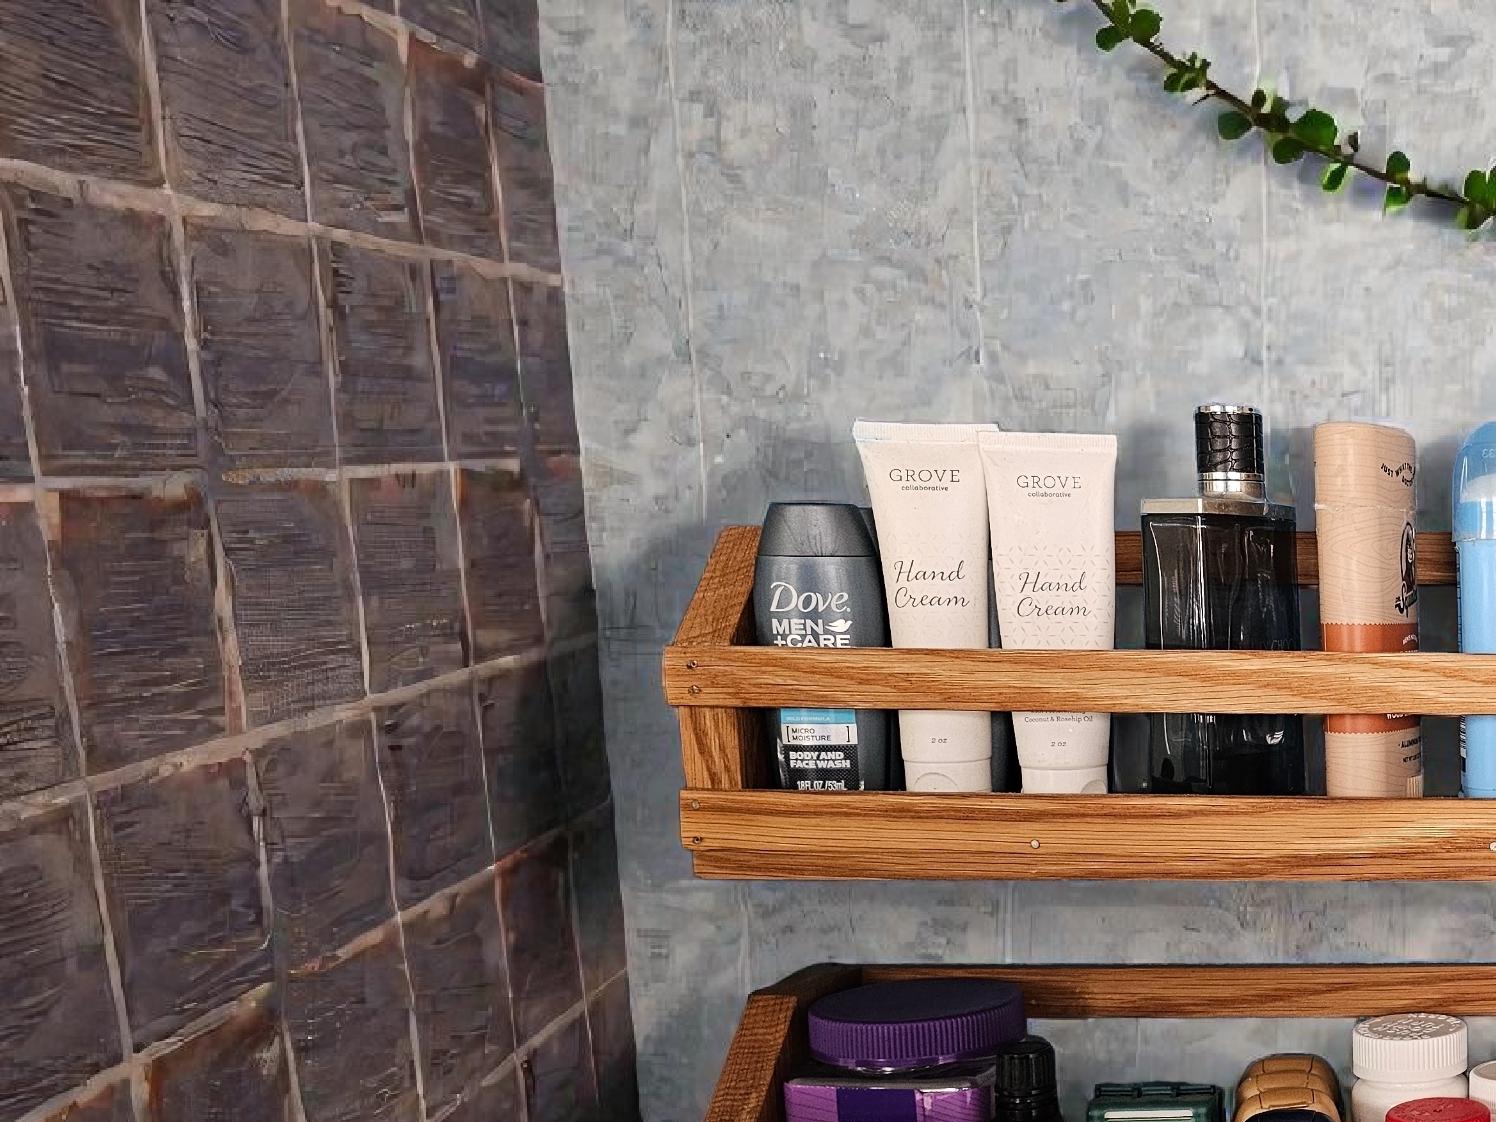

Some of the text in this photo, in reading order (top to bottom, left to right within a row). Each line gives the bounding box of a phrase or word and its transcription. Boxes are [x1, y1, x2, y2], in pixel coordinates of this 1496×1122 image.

[889, 468, 960, 482] GROVE
[1016, 475, 1082, 489] GROVE
[894, 559, 965, 583] Hand
[1018, 571, 1087, 593] Hand
[894, 586, 970, 608] Cream
[1017, 597, 1092, 617] Cream
[772, 619, 823, 634] MEN
[774, 635, 850, 648] +CARE
[789, 751, 844, 759] BODY AND
